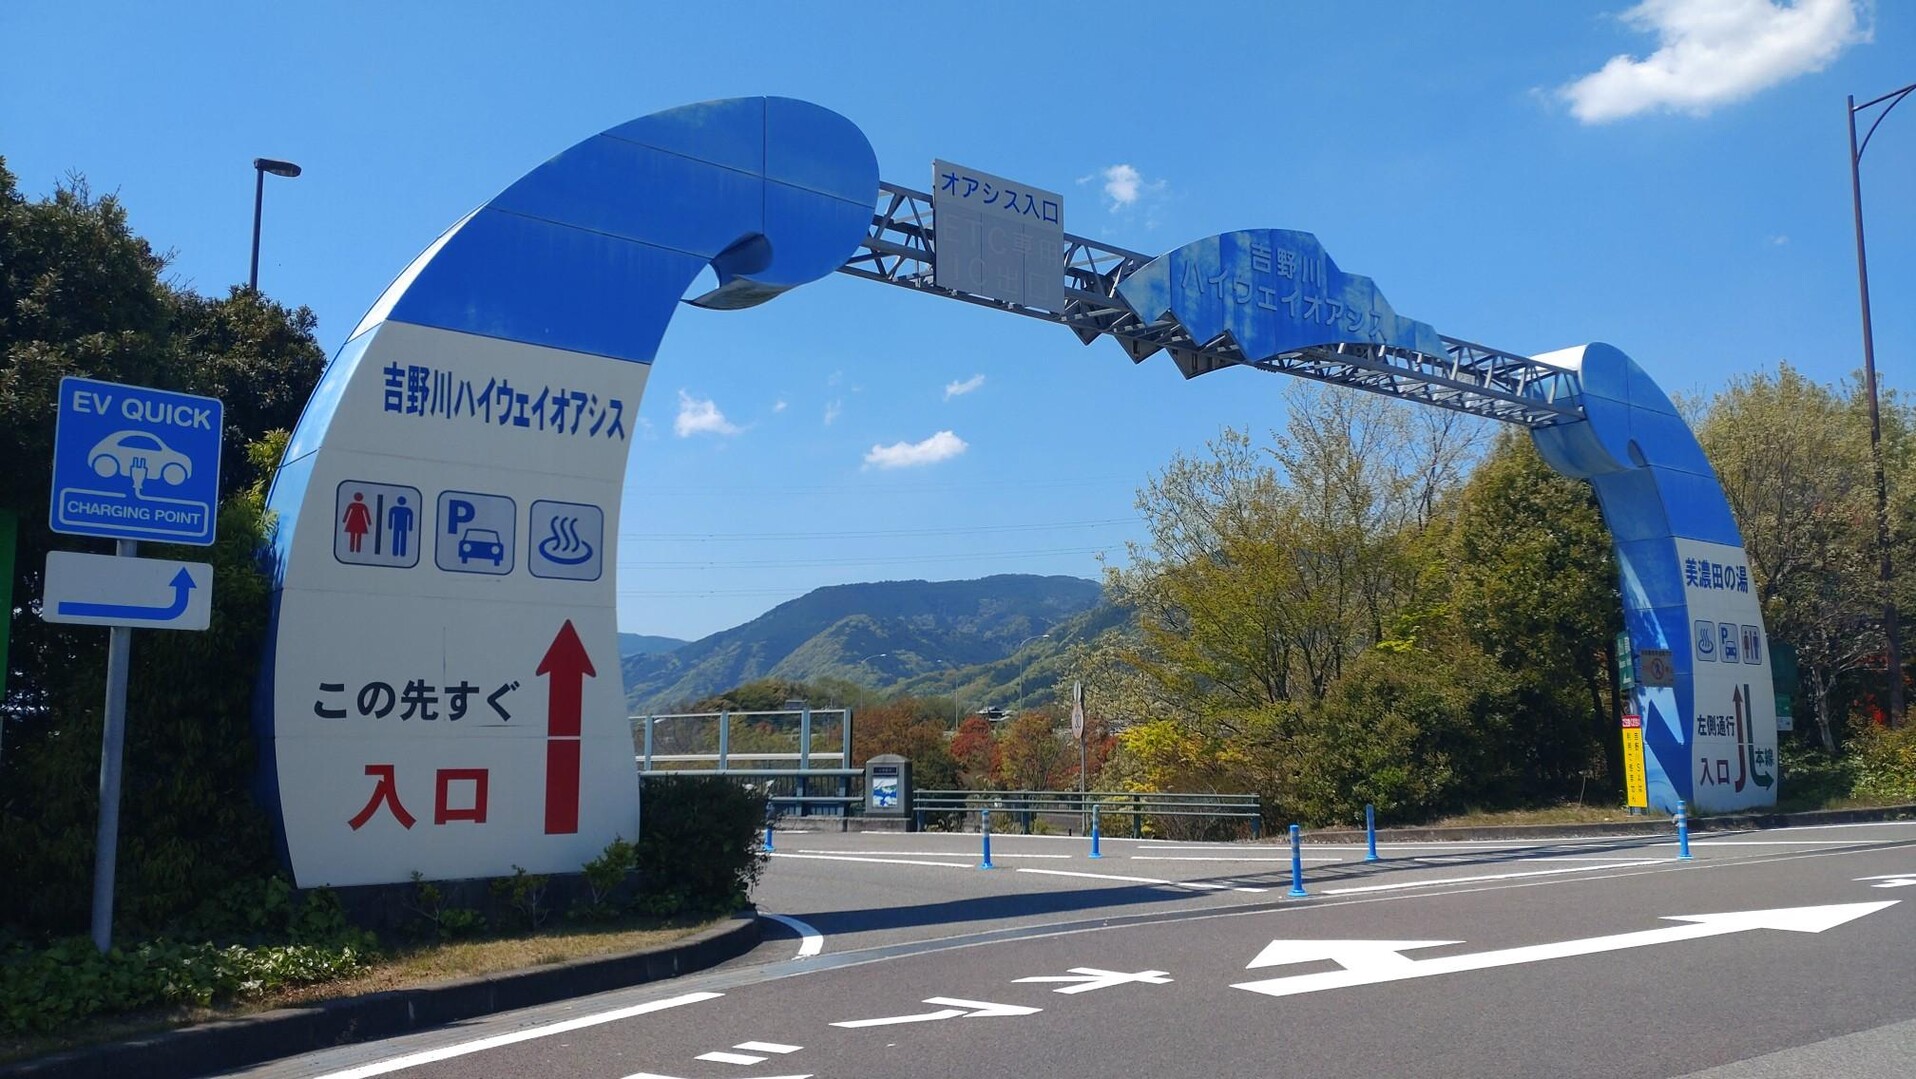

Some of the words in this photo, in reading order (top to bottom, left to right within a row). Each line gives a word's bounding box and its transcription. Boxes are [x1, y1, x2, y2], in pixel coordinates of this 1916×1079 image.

[941, 172, 1059, 224] オアシス入口
[1250, 241, 1322, 288] 吉野川
[73, 390, 112, 415] EV
[121, 398, 211, 430] QUICK
[383, 361, 625, 441] 吉野川ハイウェイオアシス
[67, 500, 150, 520] CHARGING
[154, 509, 201, 525] POINT
[449, 500, 475, 534] P
[1685, 557, 1748, 593] 美濃田の湯
[314, 679, 520, 722] この先すぐ
[1697, 714, 1735, 737] 左側通行
[1700, 757, 1730, 786] 入口
[347, 764, 489, 831] 入口
